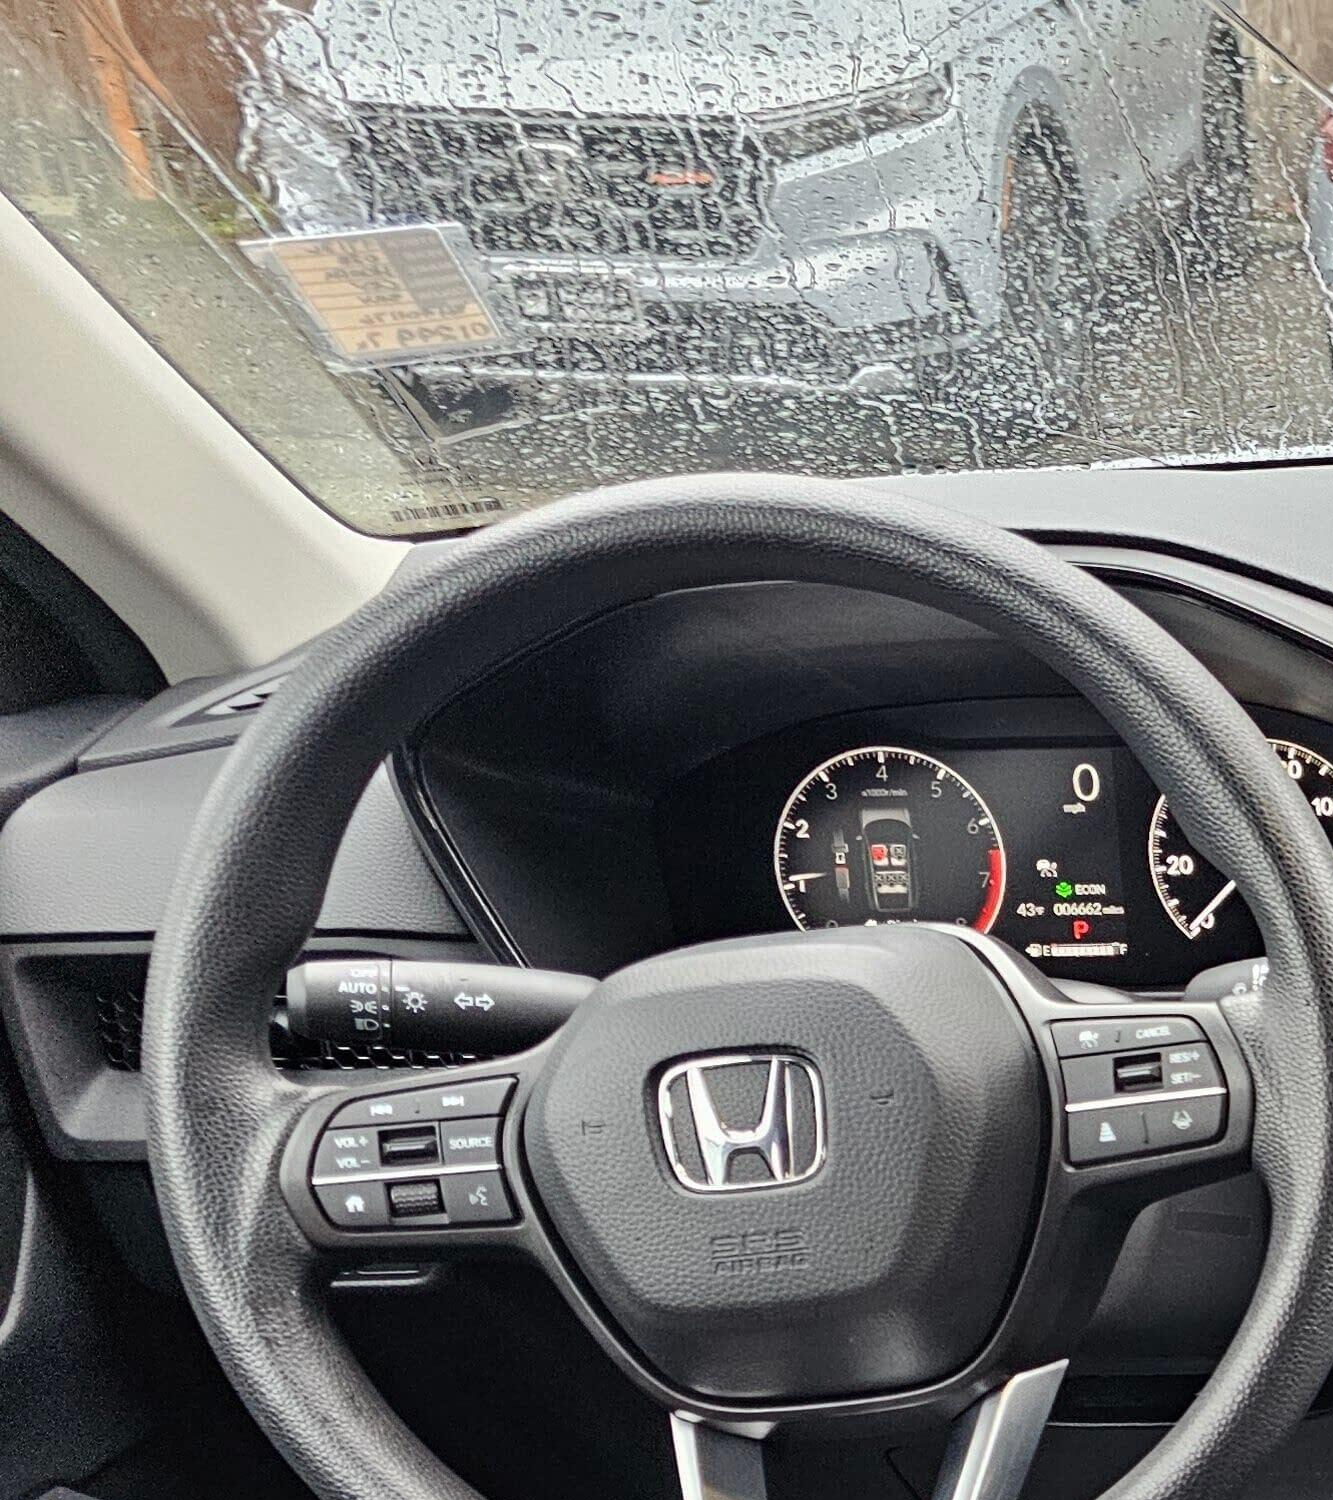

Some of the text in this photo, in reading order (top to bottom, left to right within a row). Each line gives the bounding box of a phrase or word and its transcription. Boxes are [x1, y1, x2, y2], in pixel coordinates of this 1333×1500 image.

[875, 765, 888, 782] 4
[1072, 763, 1100, 801] 0
[825, 784, 837, 800] 3
[931, 784, 942, 798] 5
[796, 819, 810, 839] 2
[967, 823, 978, 835] 6
[1166, 855, 1194, 876] 20
[979, 872, 991, 888] 7
[1075, 884, 1105, 895] ECON
[1073, 920, 1090, 939] P
[338, 982, 377, 994] AUTO
[334, 1136, 355, 1149] VOL
[449, 1136, 493, 1150] SOURCE
